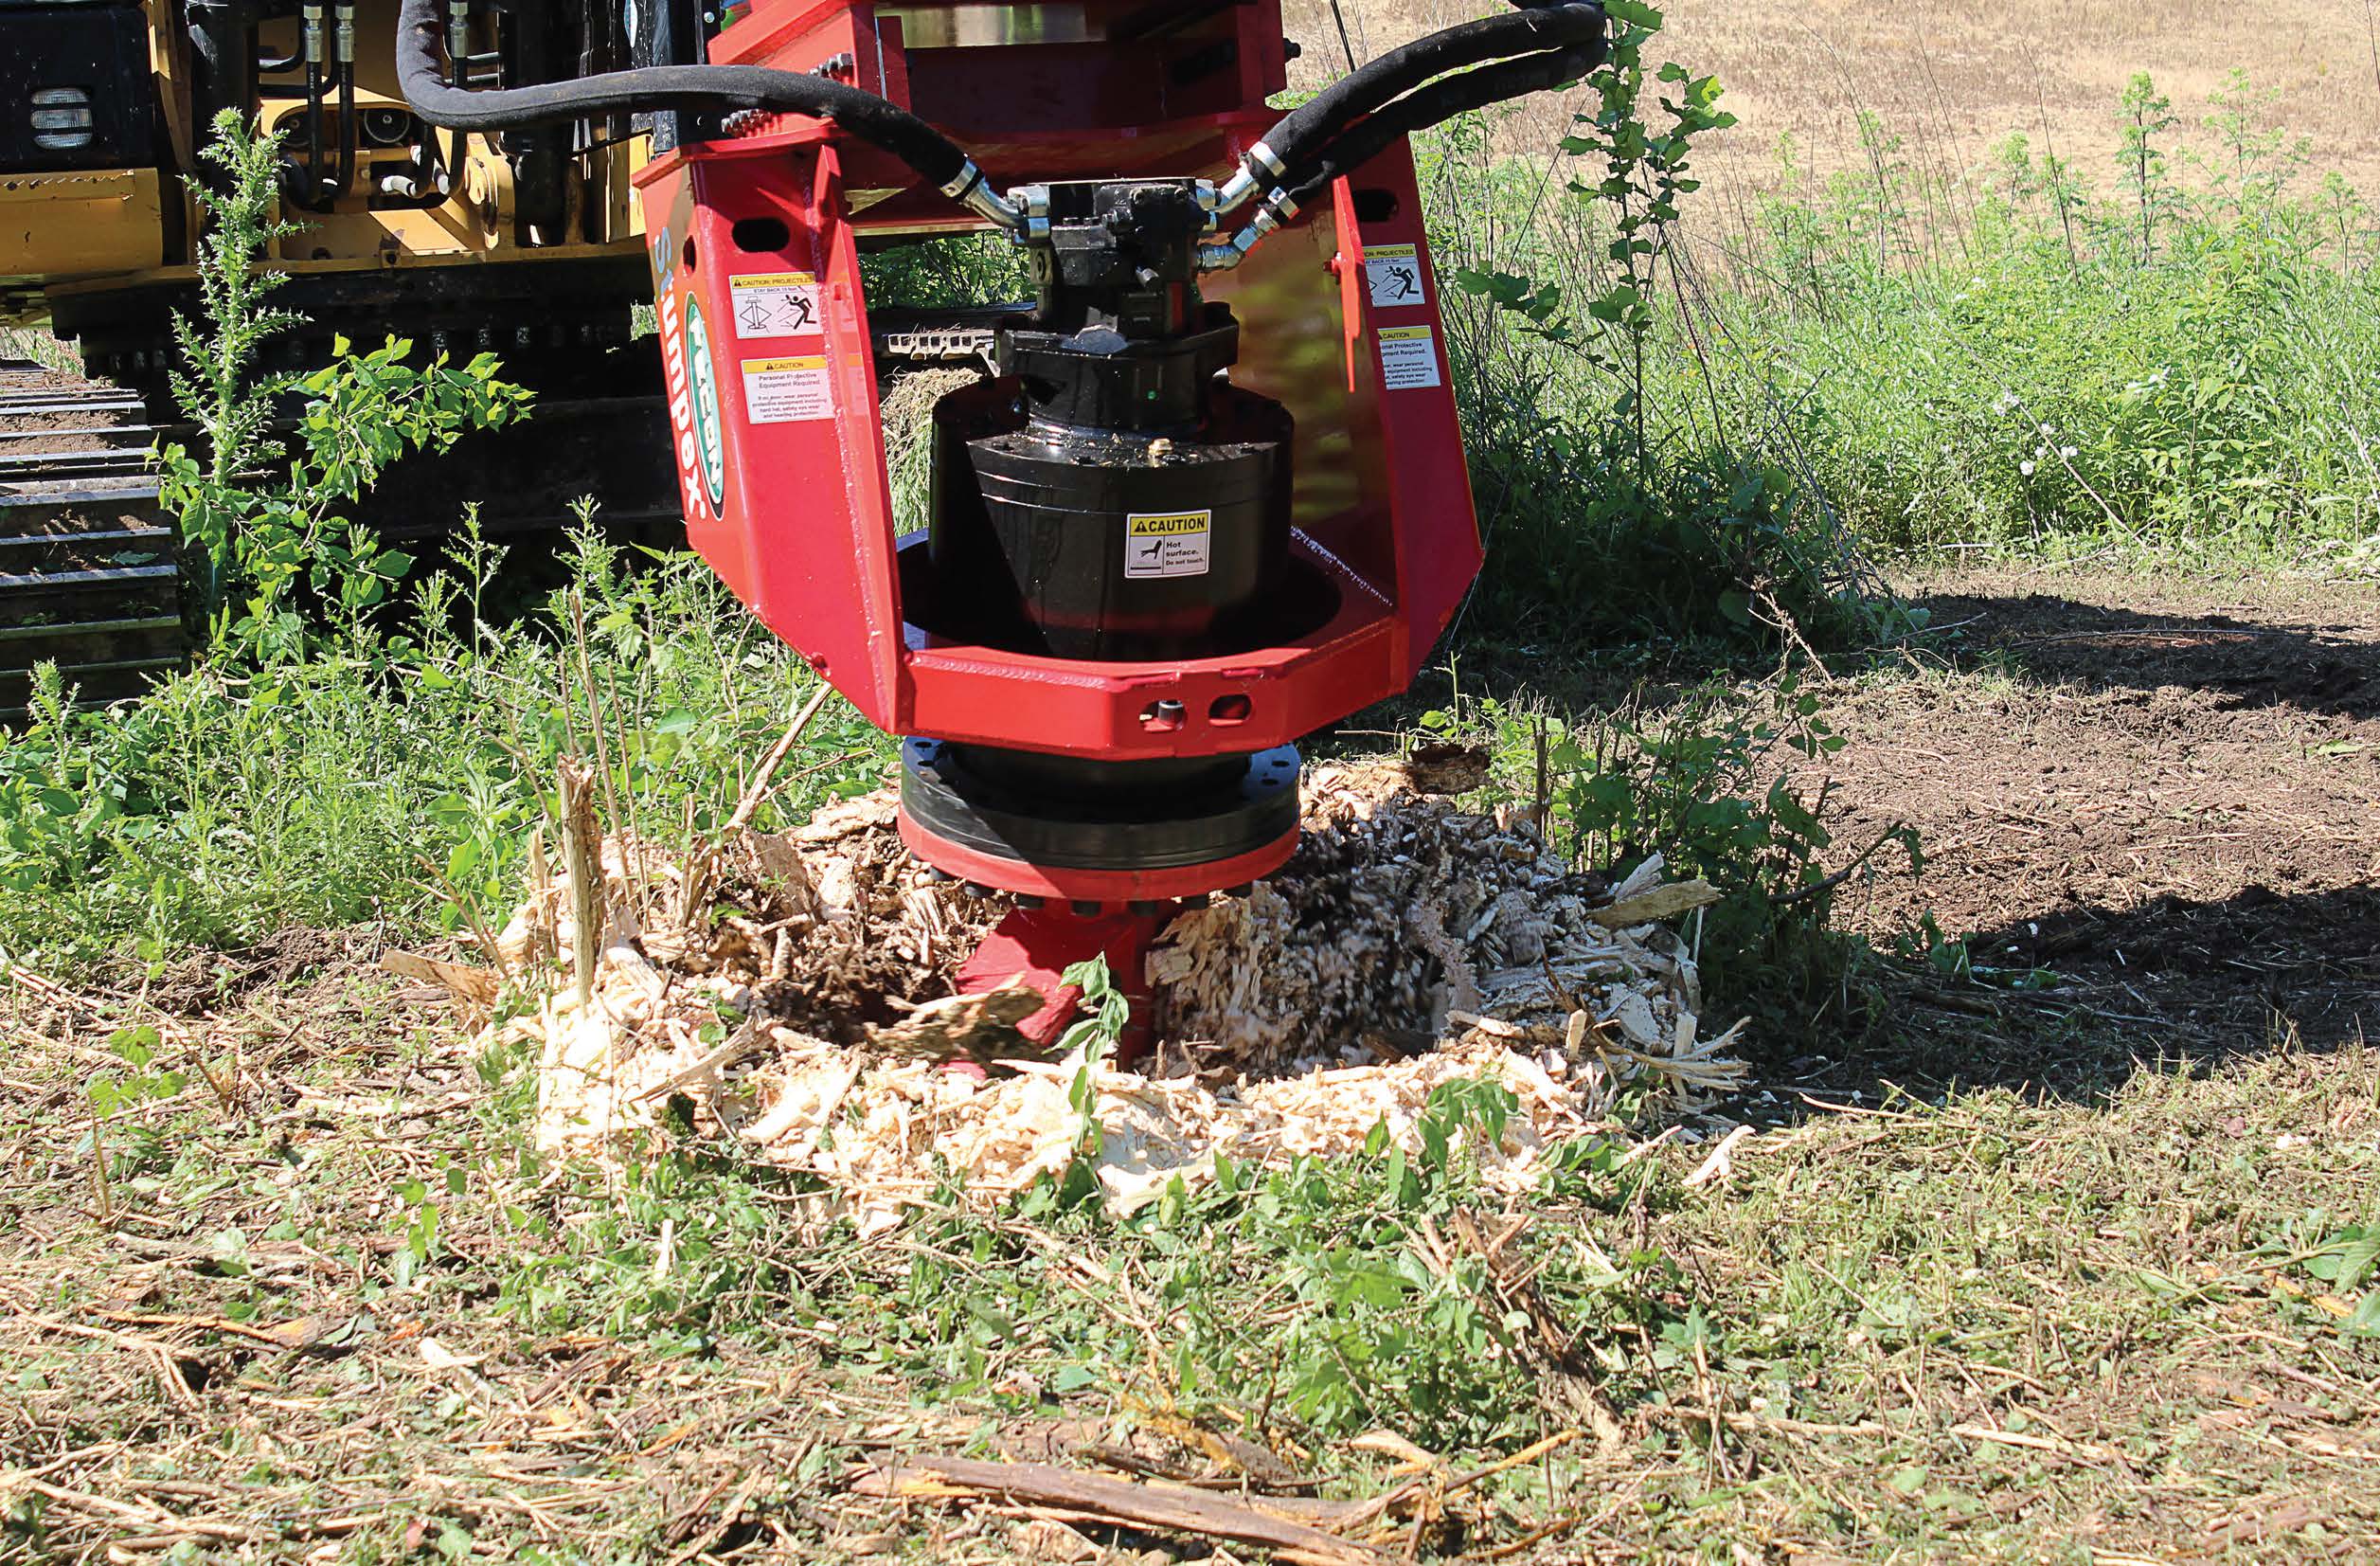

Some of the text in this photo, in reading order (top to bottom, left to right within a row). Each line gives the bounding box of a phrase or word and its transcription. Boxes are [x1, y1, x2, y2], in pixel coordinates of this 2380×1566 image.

[759, 381, 793, 389] Equipment
[1149, 516, 1206, 532] CAUTION
[1166, 549, 1199, 557] surface.
